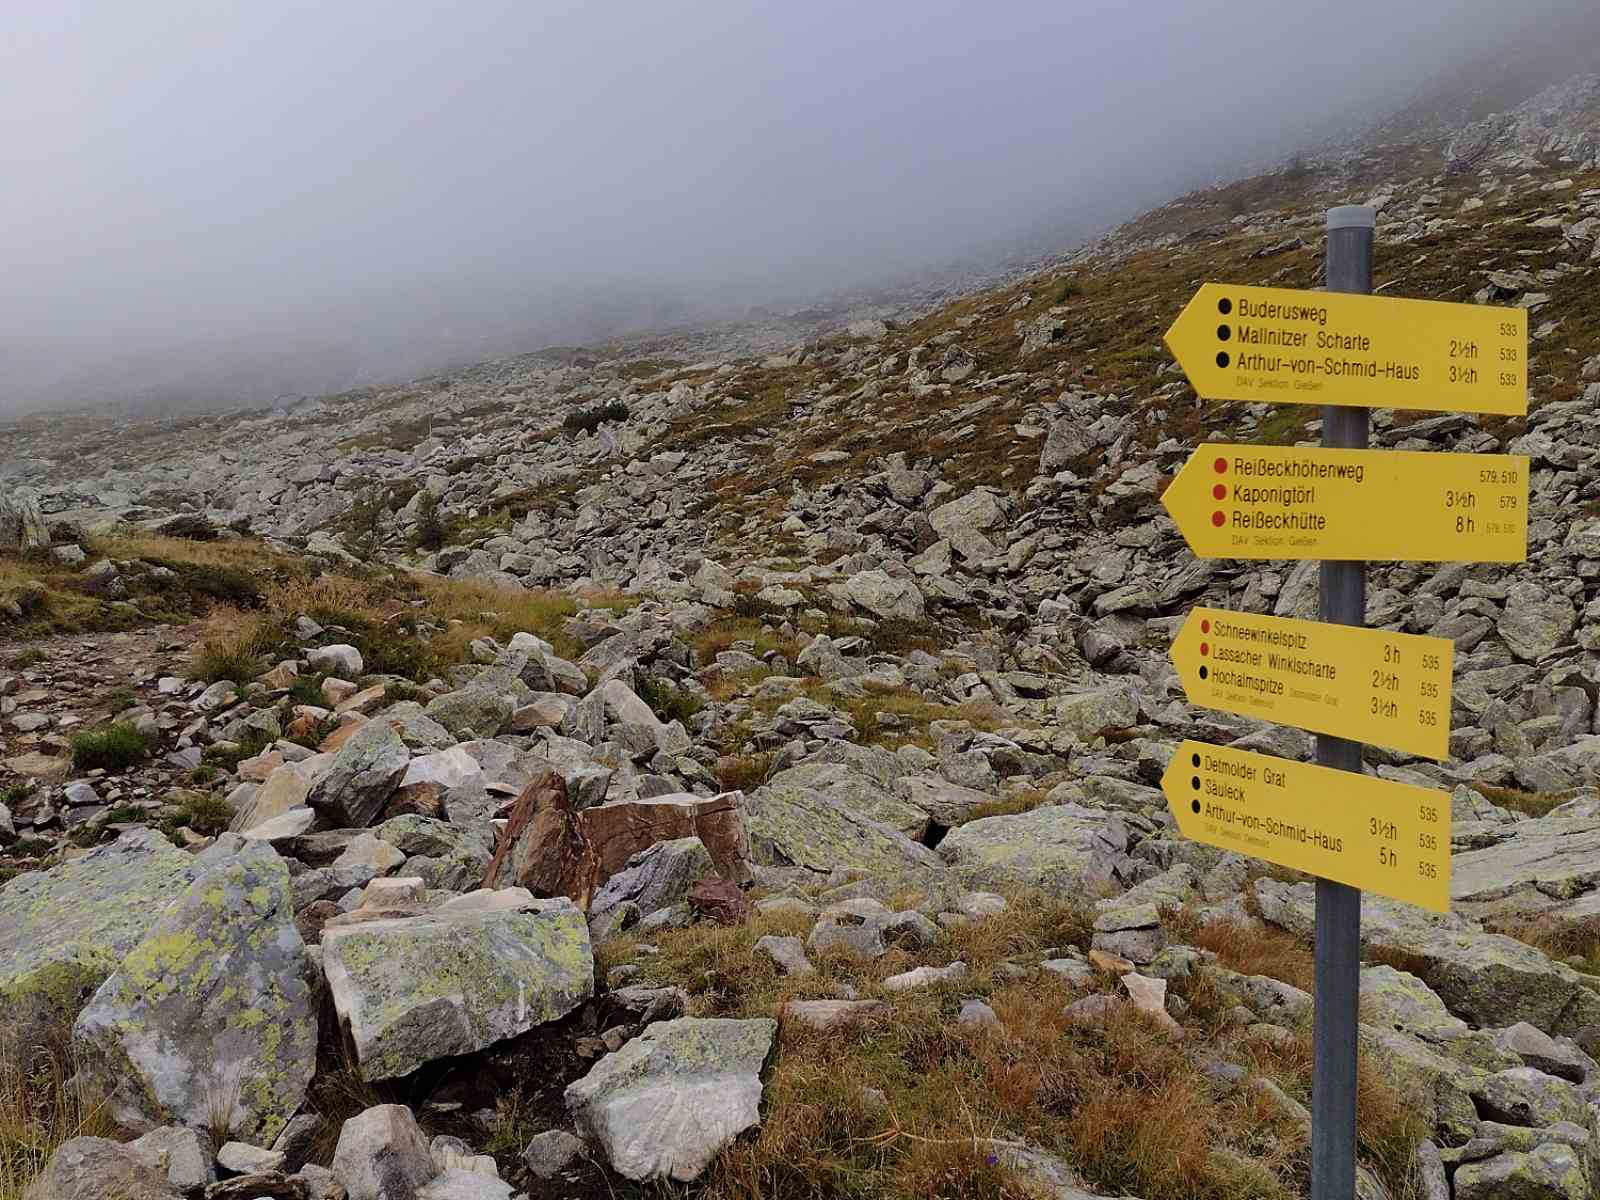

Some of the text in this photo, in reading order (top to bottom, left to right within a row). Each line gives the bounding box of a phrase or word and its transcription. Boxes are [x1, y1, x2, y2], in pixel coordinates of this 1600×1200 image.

[1239, 299, 1518, 336] Buderusweg 533
[1237, 326, 1307, 347] Mallnitzer
[1316, 331, 1370, 351] Scharte
[1500, 347, 1517, 361] 533
[1236, 352, 1420, 380] Arthur-von-Schmid-Haus
[1500, 372, 1517, 386] 533
[1234, 458, 1364, 483] Reißeckhöhenweg
[1501, 471, 1518, 484] 510
[1233, 484, 1315, 507] Kaponigtörl
[1500, 495, 1517, 509] 579
[1232, 511, 1326, 530] Reißeckhütte
[1231, 534, 1249, 546] DAV
[1214, 621, 1307, 651] Schneewinkelspitz
[1422, 654, 1440, 670] 535
[1212, 644, 1263, 666] Lassacher
[1268, 653, 1336, 680] Winklscharte
[1420, 681, 1439, 698] 535
[1212, 667, 1285, 695] Hochalmspitze
[1418, 709, 1437, 726] 535
[1204, 755, 1438, 822] Detmolder Grat 535
[1204, 801, 1343, 852] Arthur-von-Schmid-Haus
[1418, 861, 1437, 879] 535
[1419, 832, 1438, 850] 535
